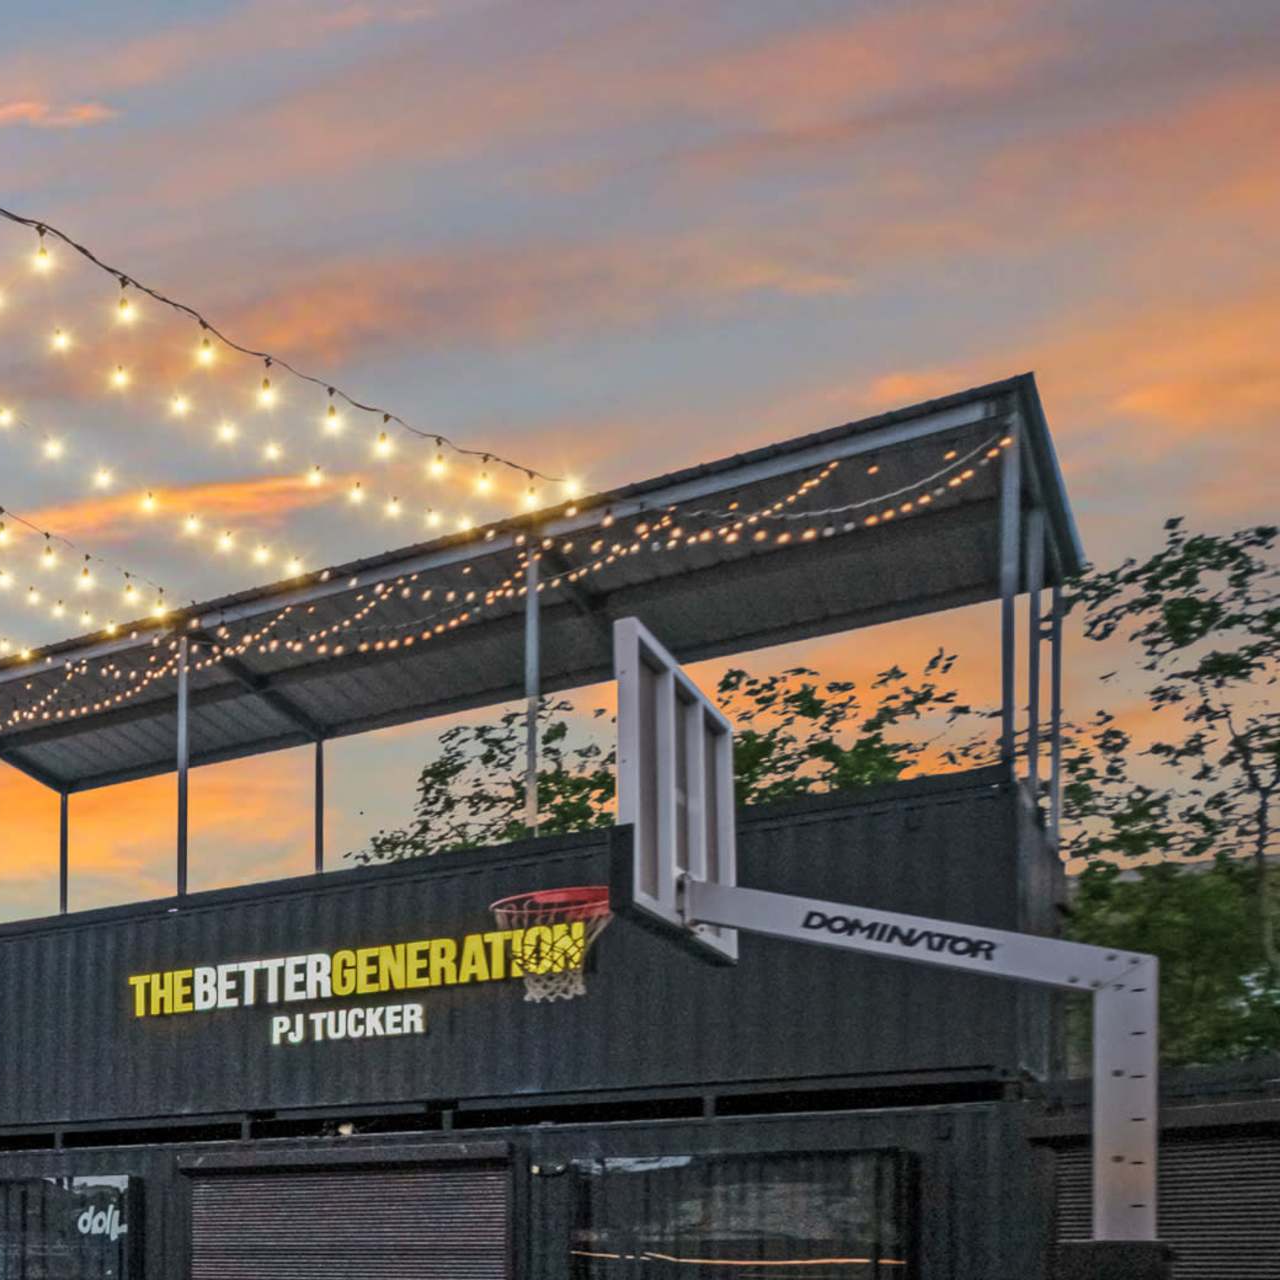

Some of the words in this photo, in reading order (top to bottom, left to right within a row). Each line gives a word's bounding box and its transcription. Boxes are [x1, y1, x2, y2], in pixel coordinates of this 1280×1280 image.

[801, 910, 997, 961] DOMINATOR
[271, 1013, 304, 1046] PJ
[310, 1003, 425, 1042] TUCKER
